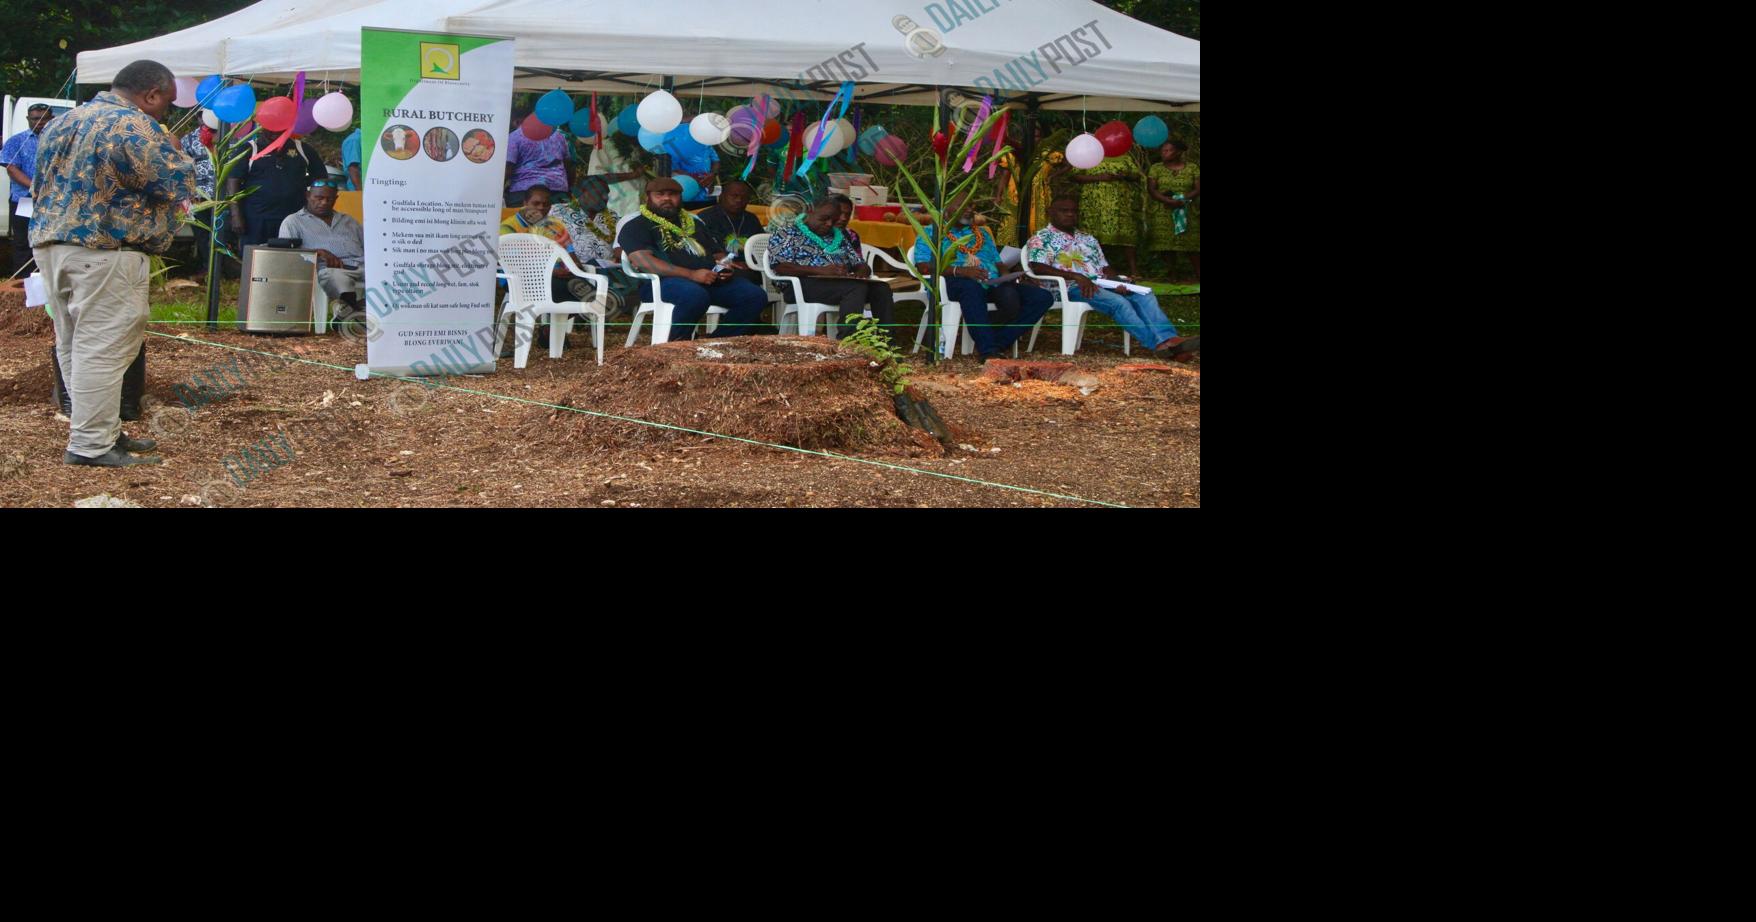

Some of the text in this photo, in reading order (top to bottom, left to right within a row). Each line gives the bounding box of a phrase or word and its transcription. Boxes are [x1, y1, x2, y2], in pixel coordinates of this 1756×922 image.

[383, 108, 495, 123] RURAL BUTCHERY
[371, 178, 407, 187] Tingting:
